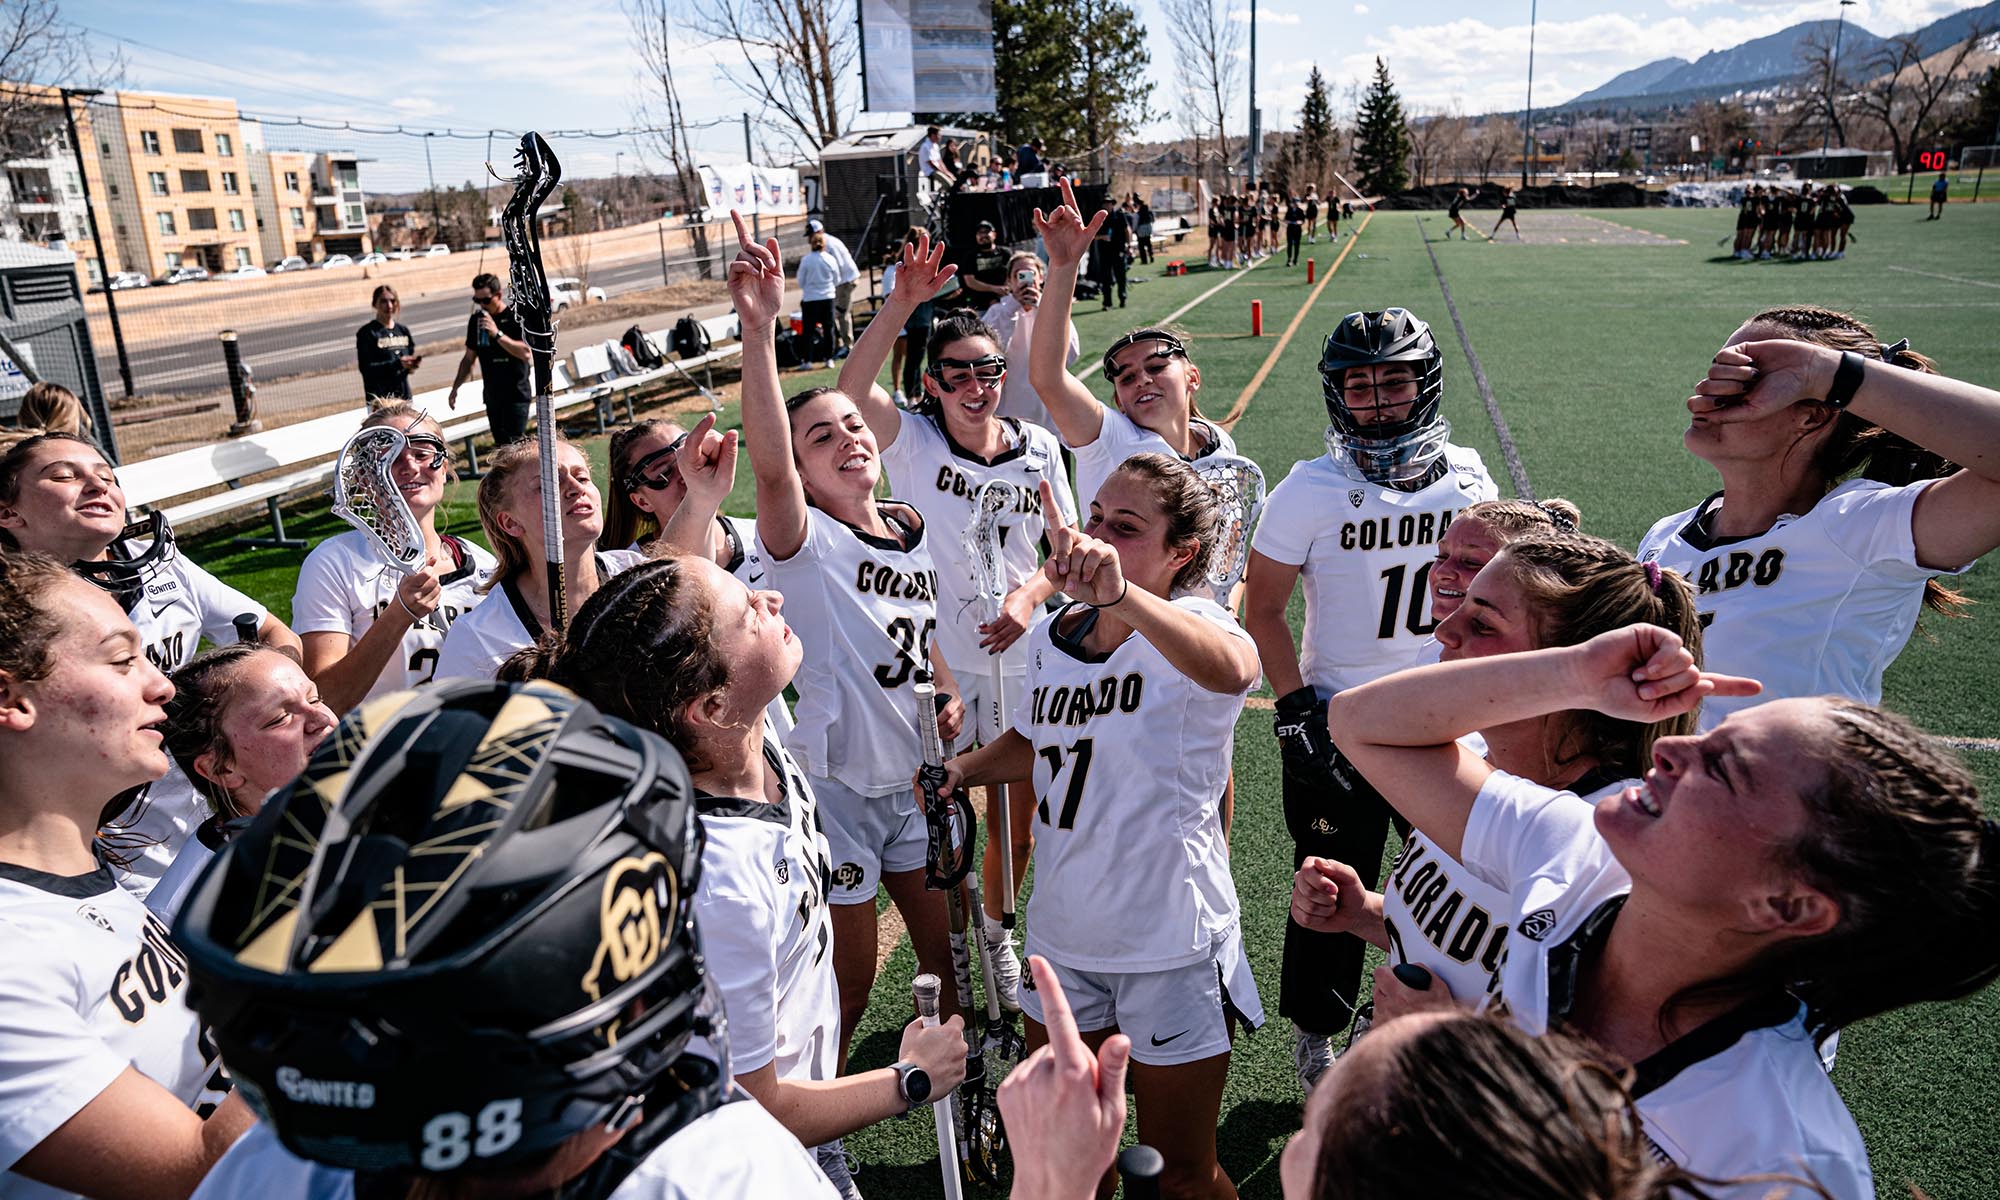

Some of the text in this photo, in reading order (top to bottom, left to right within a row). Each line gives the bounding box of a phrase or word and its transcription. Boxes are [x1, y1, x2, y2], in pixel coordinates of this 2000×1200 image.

[1920, 151, 1945, 170] 90
[1340, 508, 1464, 550] COLORA
[1685, 548, 1785, 595] ADO
[1378, 561, 1442, 640] 10
[1278, 722, 1307, 737] STX
[421, 1098, 522, 1171] 88
